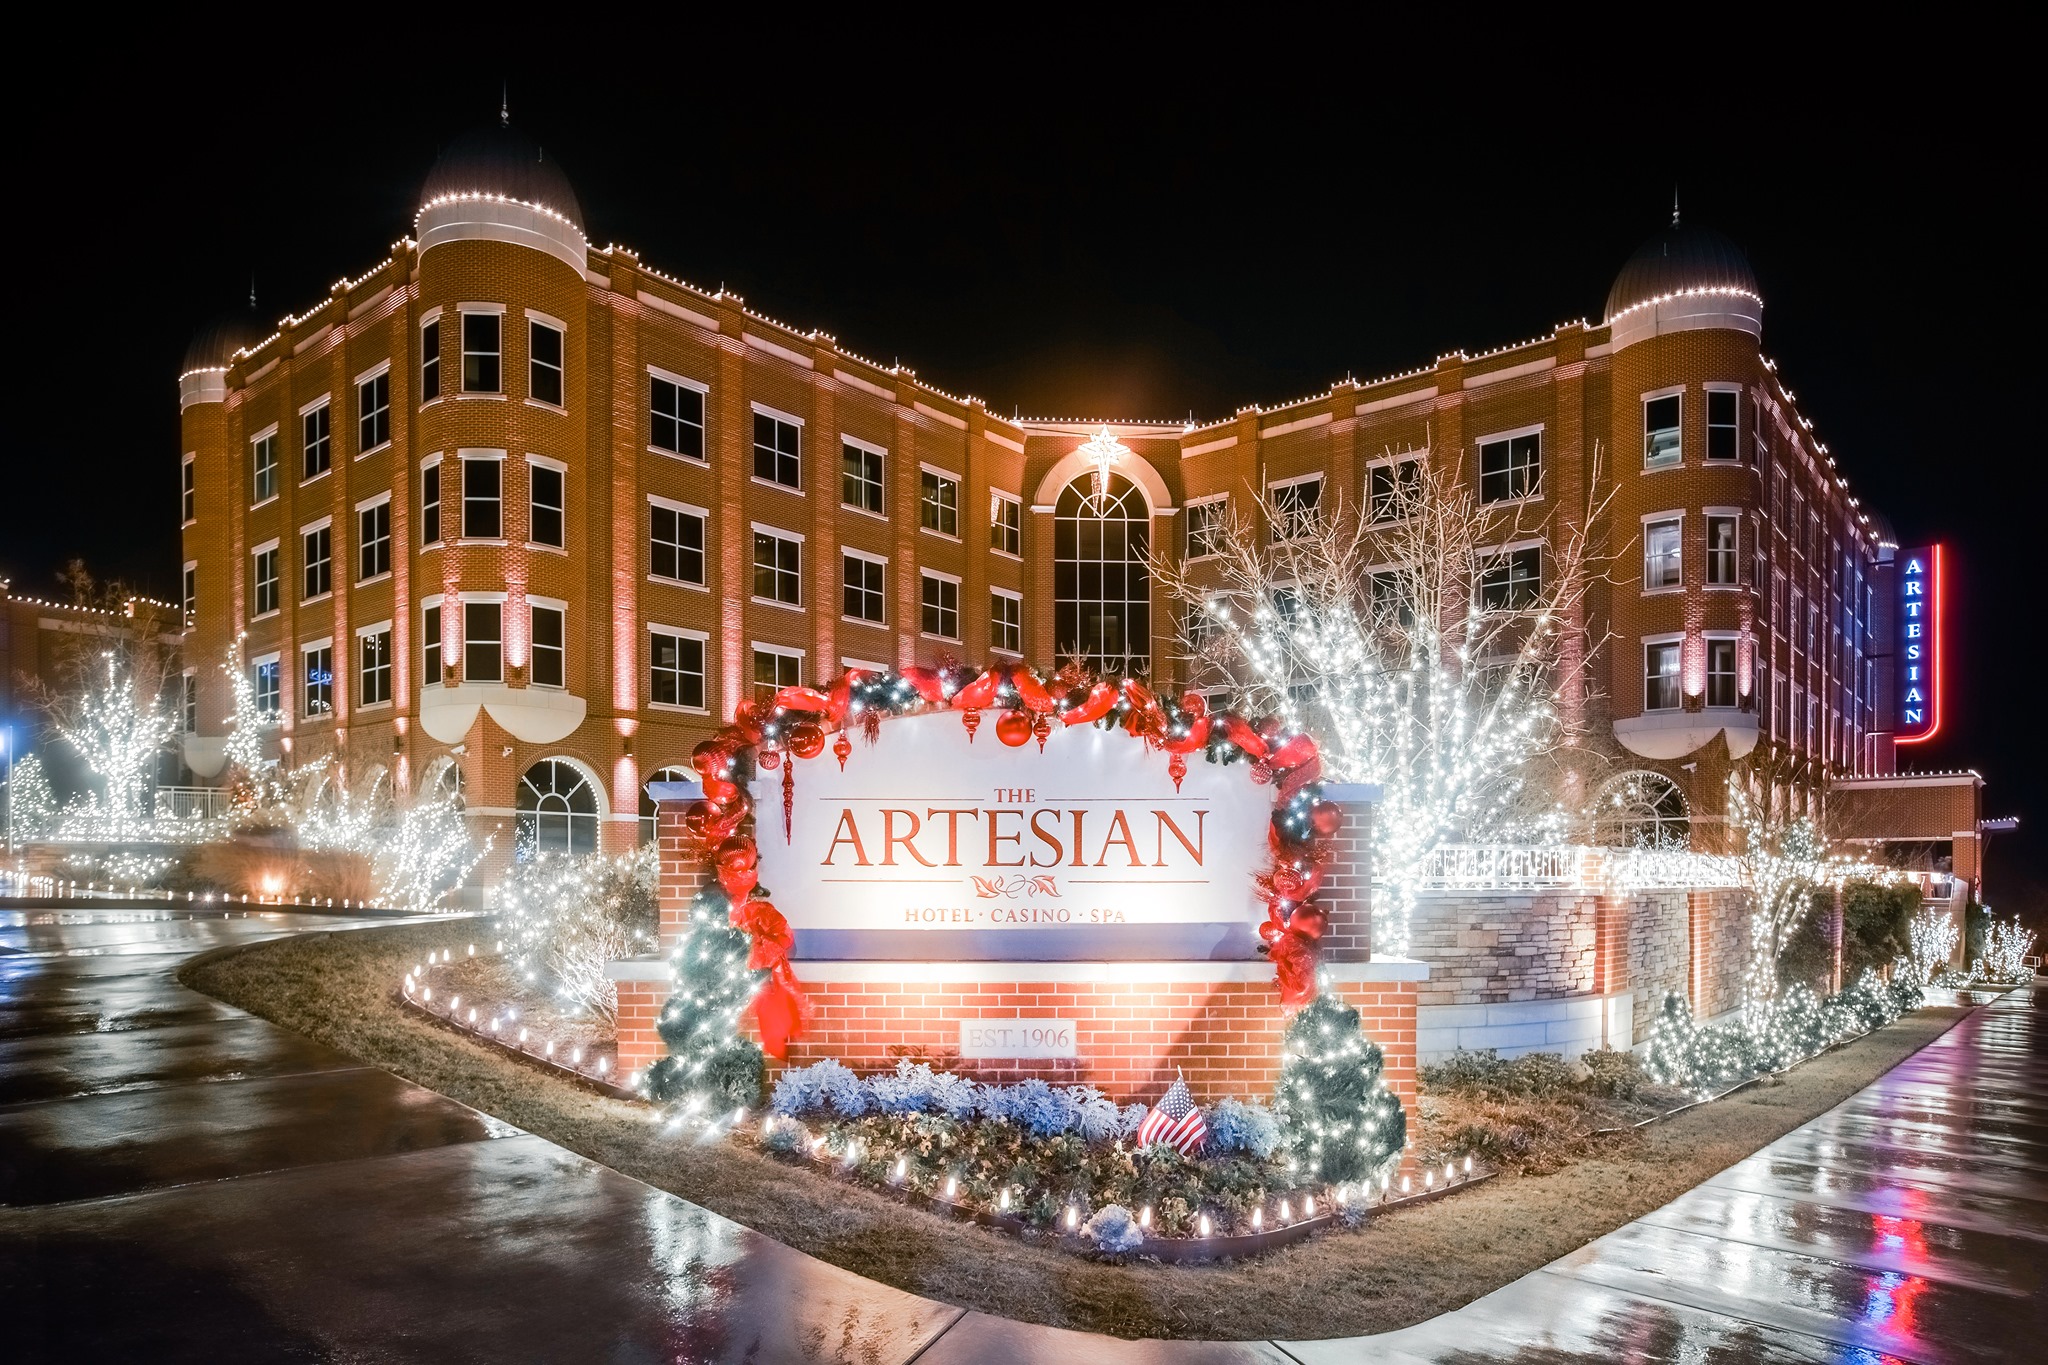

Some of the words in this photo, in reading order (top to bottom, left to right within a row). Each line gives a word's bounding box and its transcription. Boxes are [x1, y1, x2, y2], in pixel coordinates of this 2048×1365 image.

[1905, 559, 1923, 724] ARTESIAN
[993, 788, 1036, 803] THE
[820, 808, 1210, 868] ARTESIAN
[904, 907, 975, 923] HOTEL
[990, 907, 1072, 923] CASINO
[1090, 907, 1126, 923] SPA
[967, 1028, 1017, 1049] EST.
[1021, 1027, 1070, 1049] 1906
